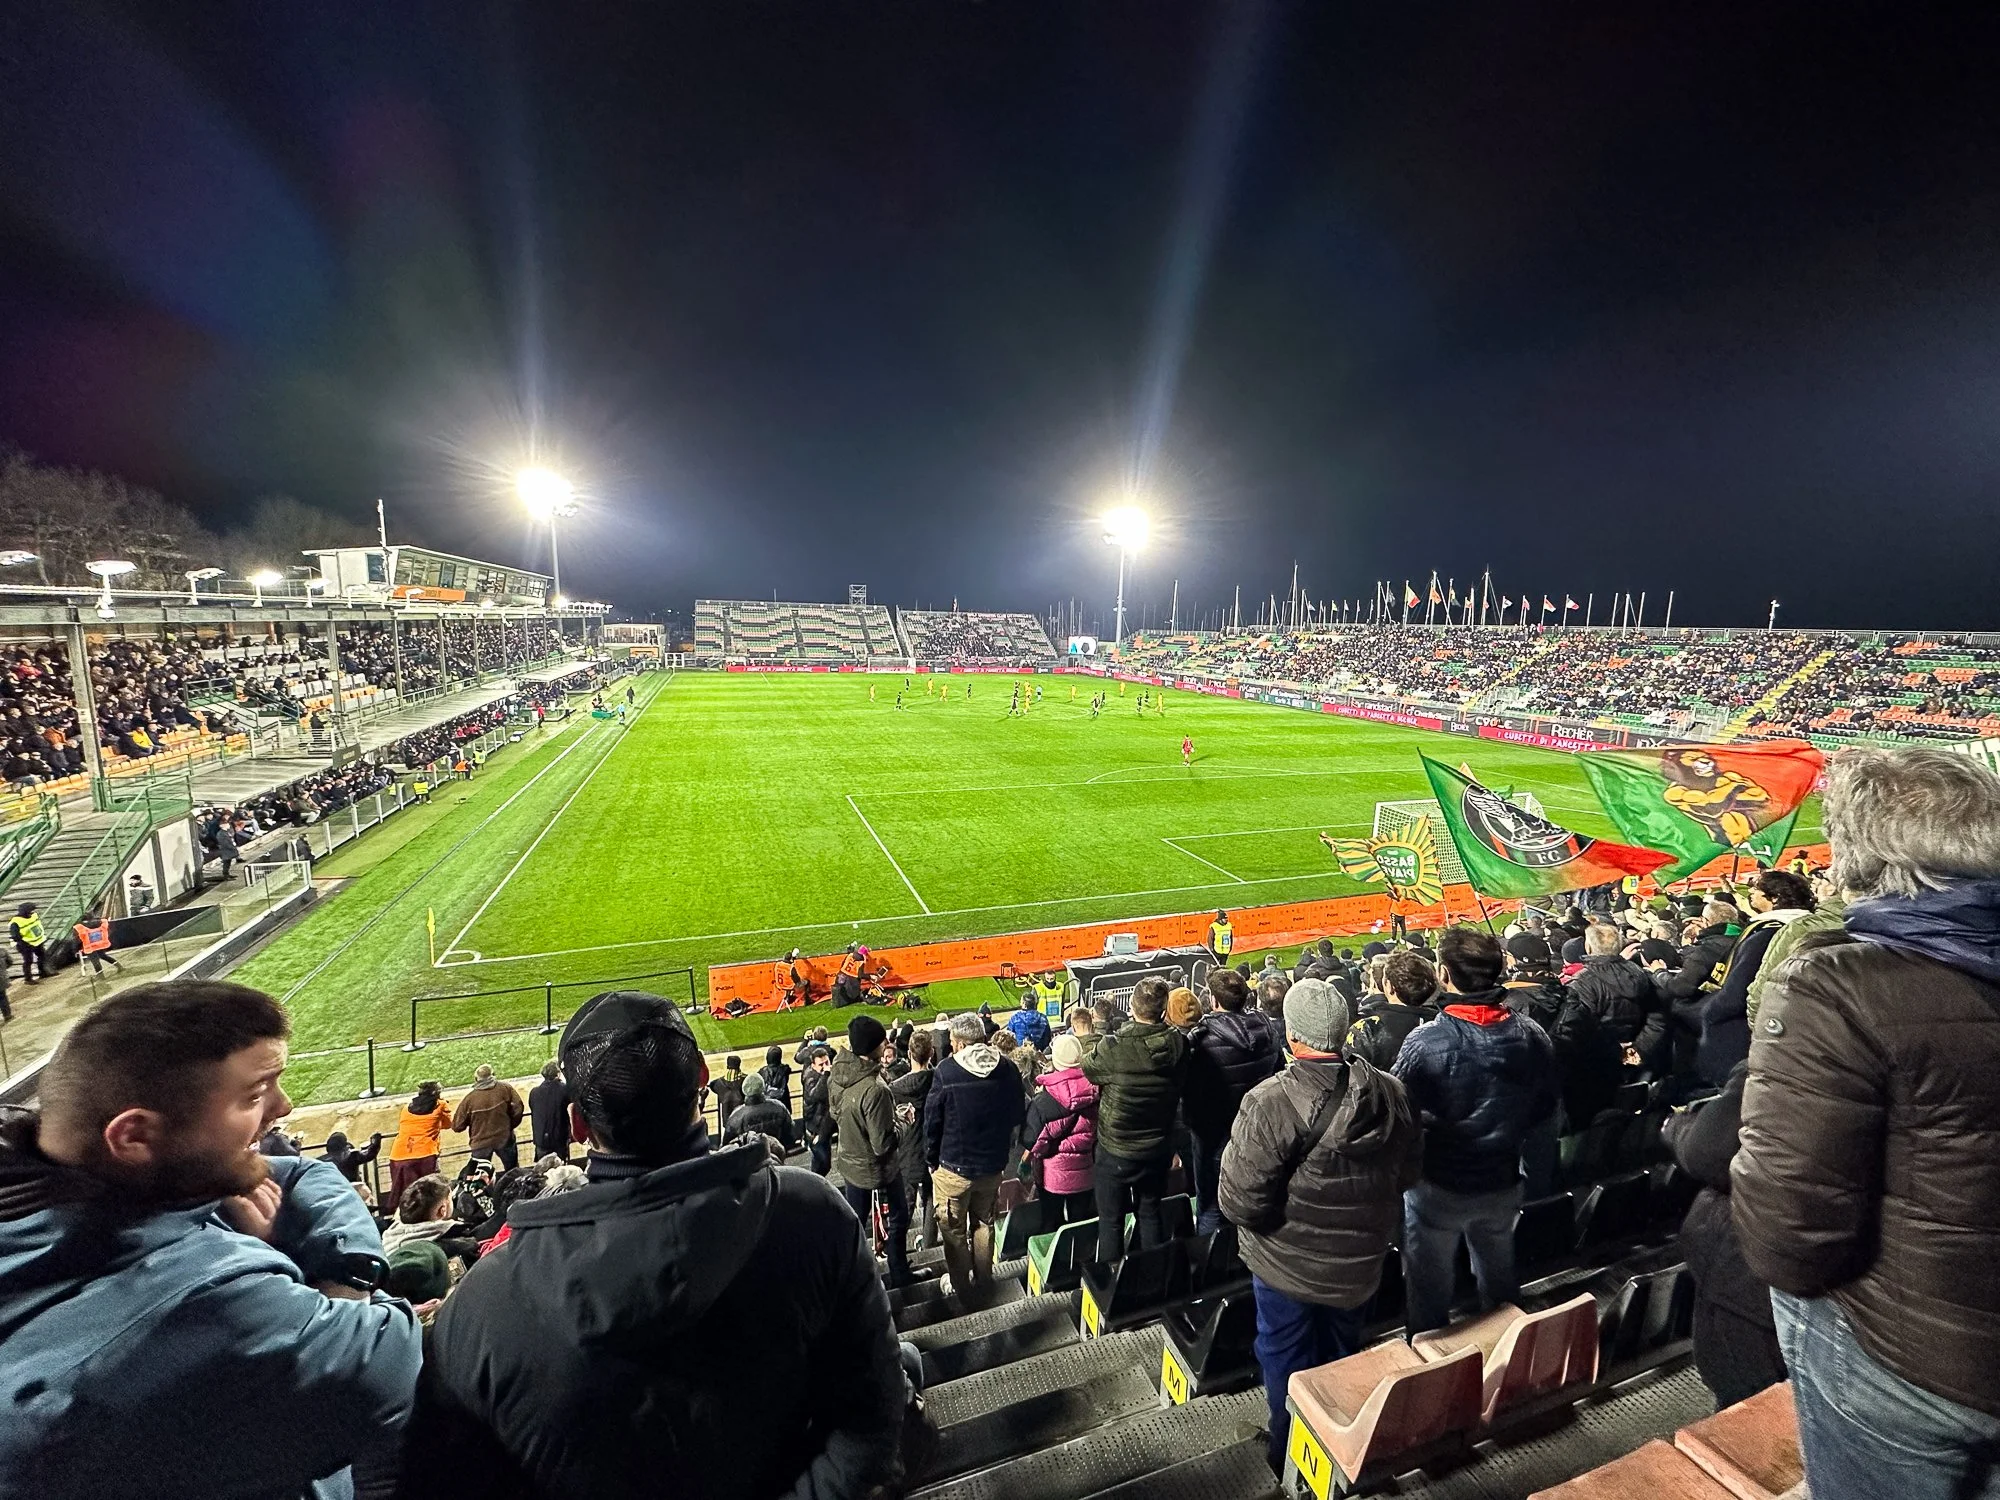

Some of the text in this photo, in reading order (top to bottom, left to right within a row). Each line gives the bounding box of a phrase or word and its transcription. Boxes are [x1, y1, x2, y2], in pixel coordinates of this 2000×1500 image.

[1365, 702, 1393, 712] randstad
[1504, 731, 1536, 743] CUBETTI
[1540, 736, 1548, 746] DI
[1551, 738, 1597, 752] PANCETTA
[1536, 851, 1560, 865] FC
[777, 973, 784, 985] 6
[1088, 1303, 1093, 1318] L
[1168, 1365, 1181, 1395] M
[1302, 1441, 1318, 1478] N
